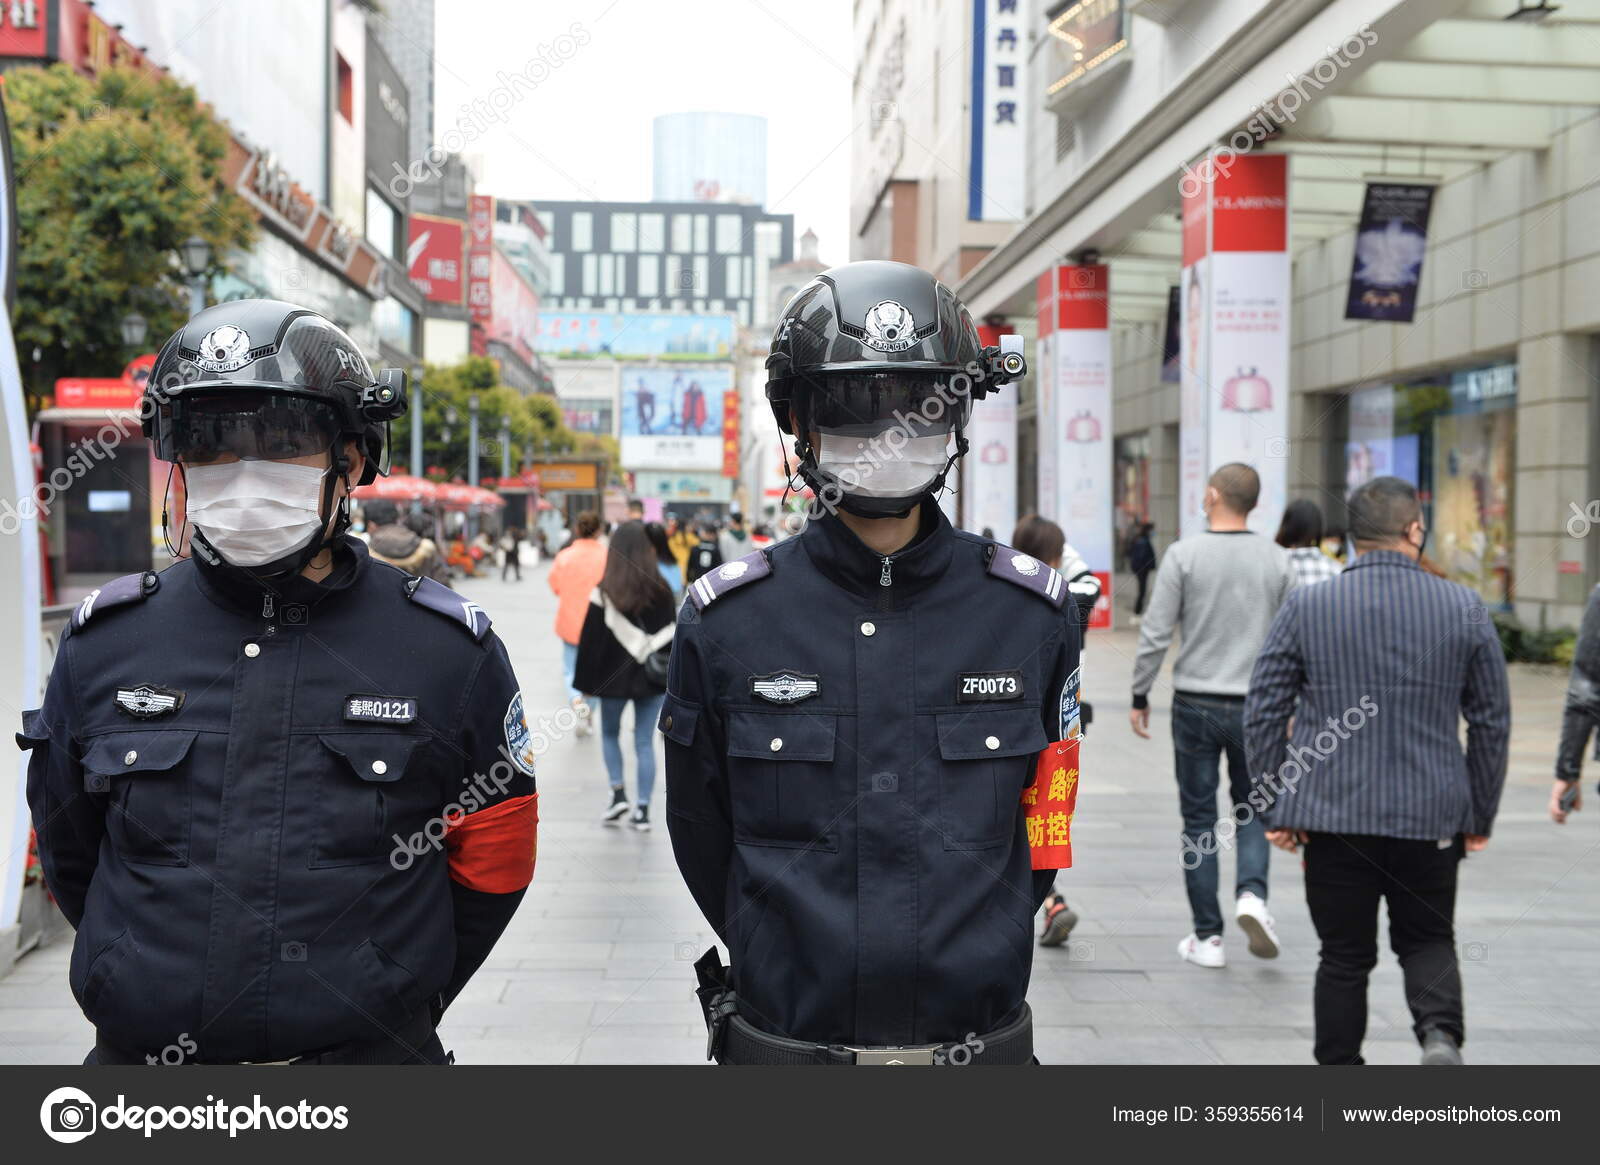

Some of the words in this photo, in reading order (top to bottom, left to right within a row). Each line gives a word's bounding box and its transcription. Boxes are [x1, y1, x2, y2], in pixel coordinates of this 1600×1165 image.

[962, 677, 1017, 694] ZF0073
[350, 699, 411, 719] 春熙0121
[1026, 811, 1073, 849] 防控
